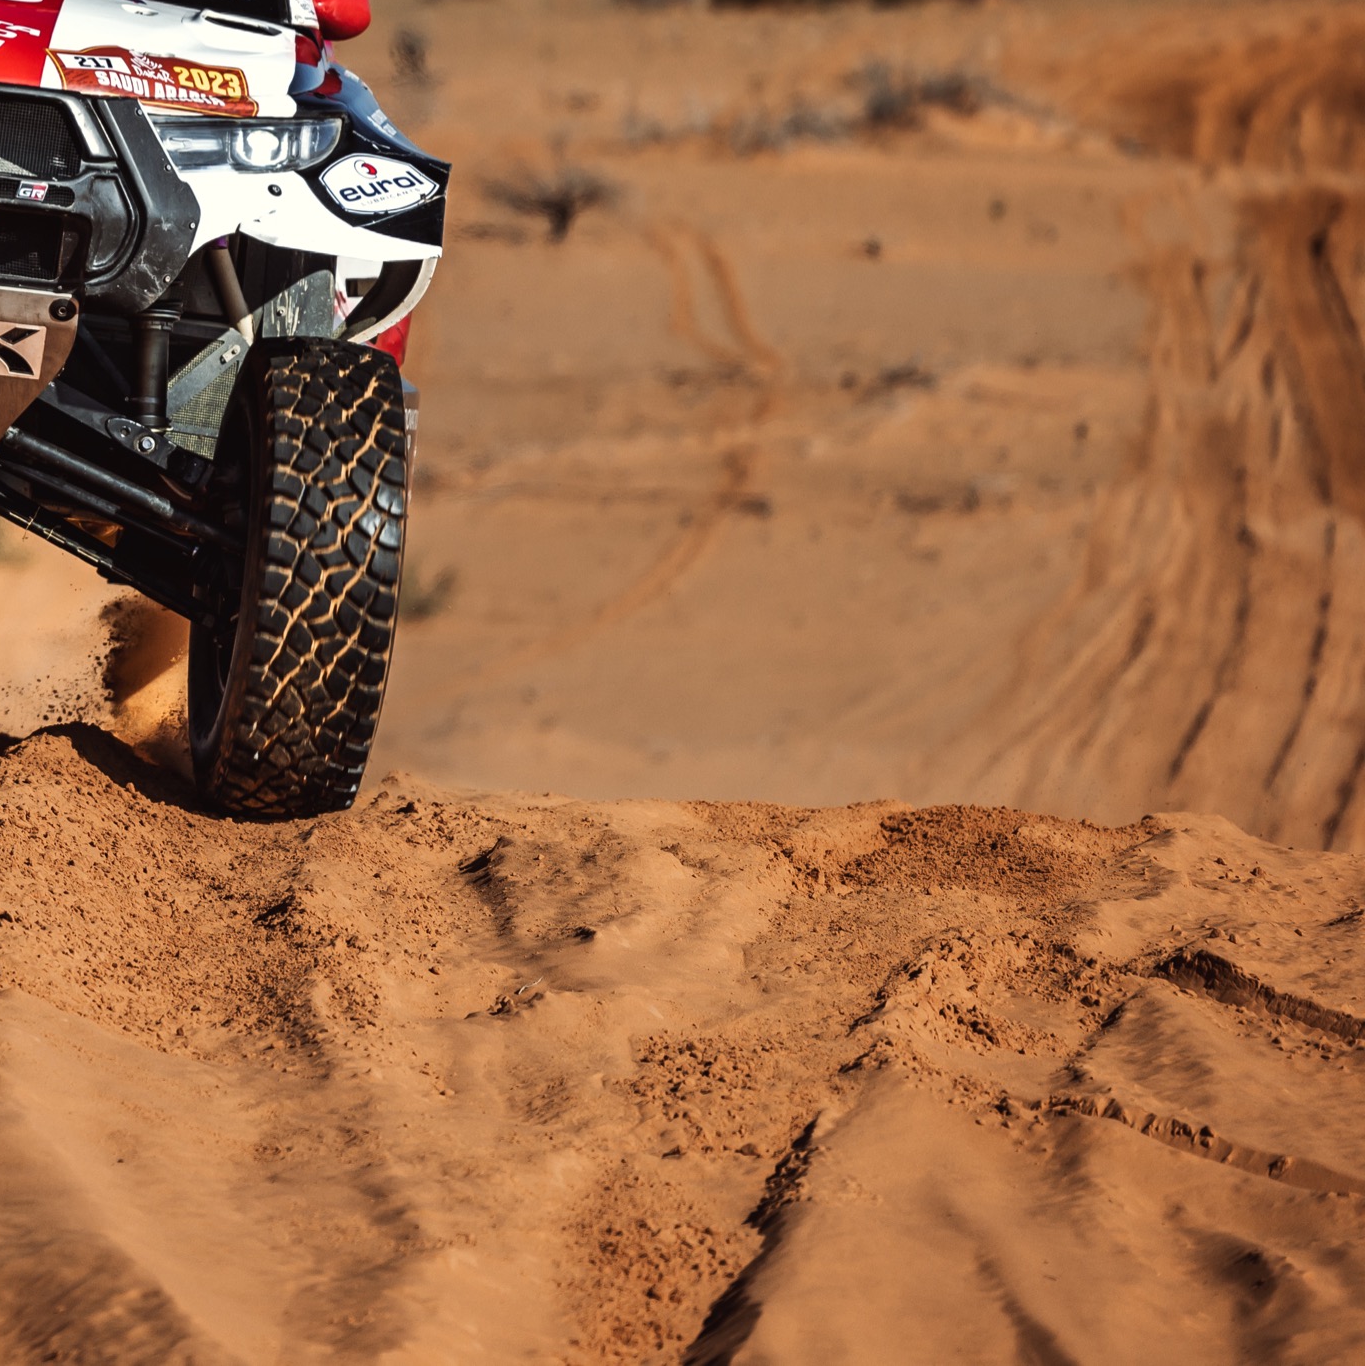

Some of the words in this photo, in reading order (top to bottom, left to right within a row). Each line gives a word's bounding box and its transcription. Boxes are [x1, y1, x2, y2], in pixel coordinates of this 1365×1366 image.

[74, 56, 114, 69] 217
[131, 64, 175, 84] DAKAR
[95, 70, 150, 98] SAUDI
[154, 81, 226, 107] ARABIA
[173, 65, 242, 98] 2023
[339, 170, 425, 202] eurol
